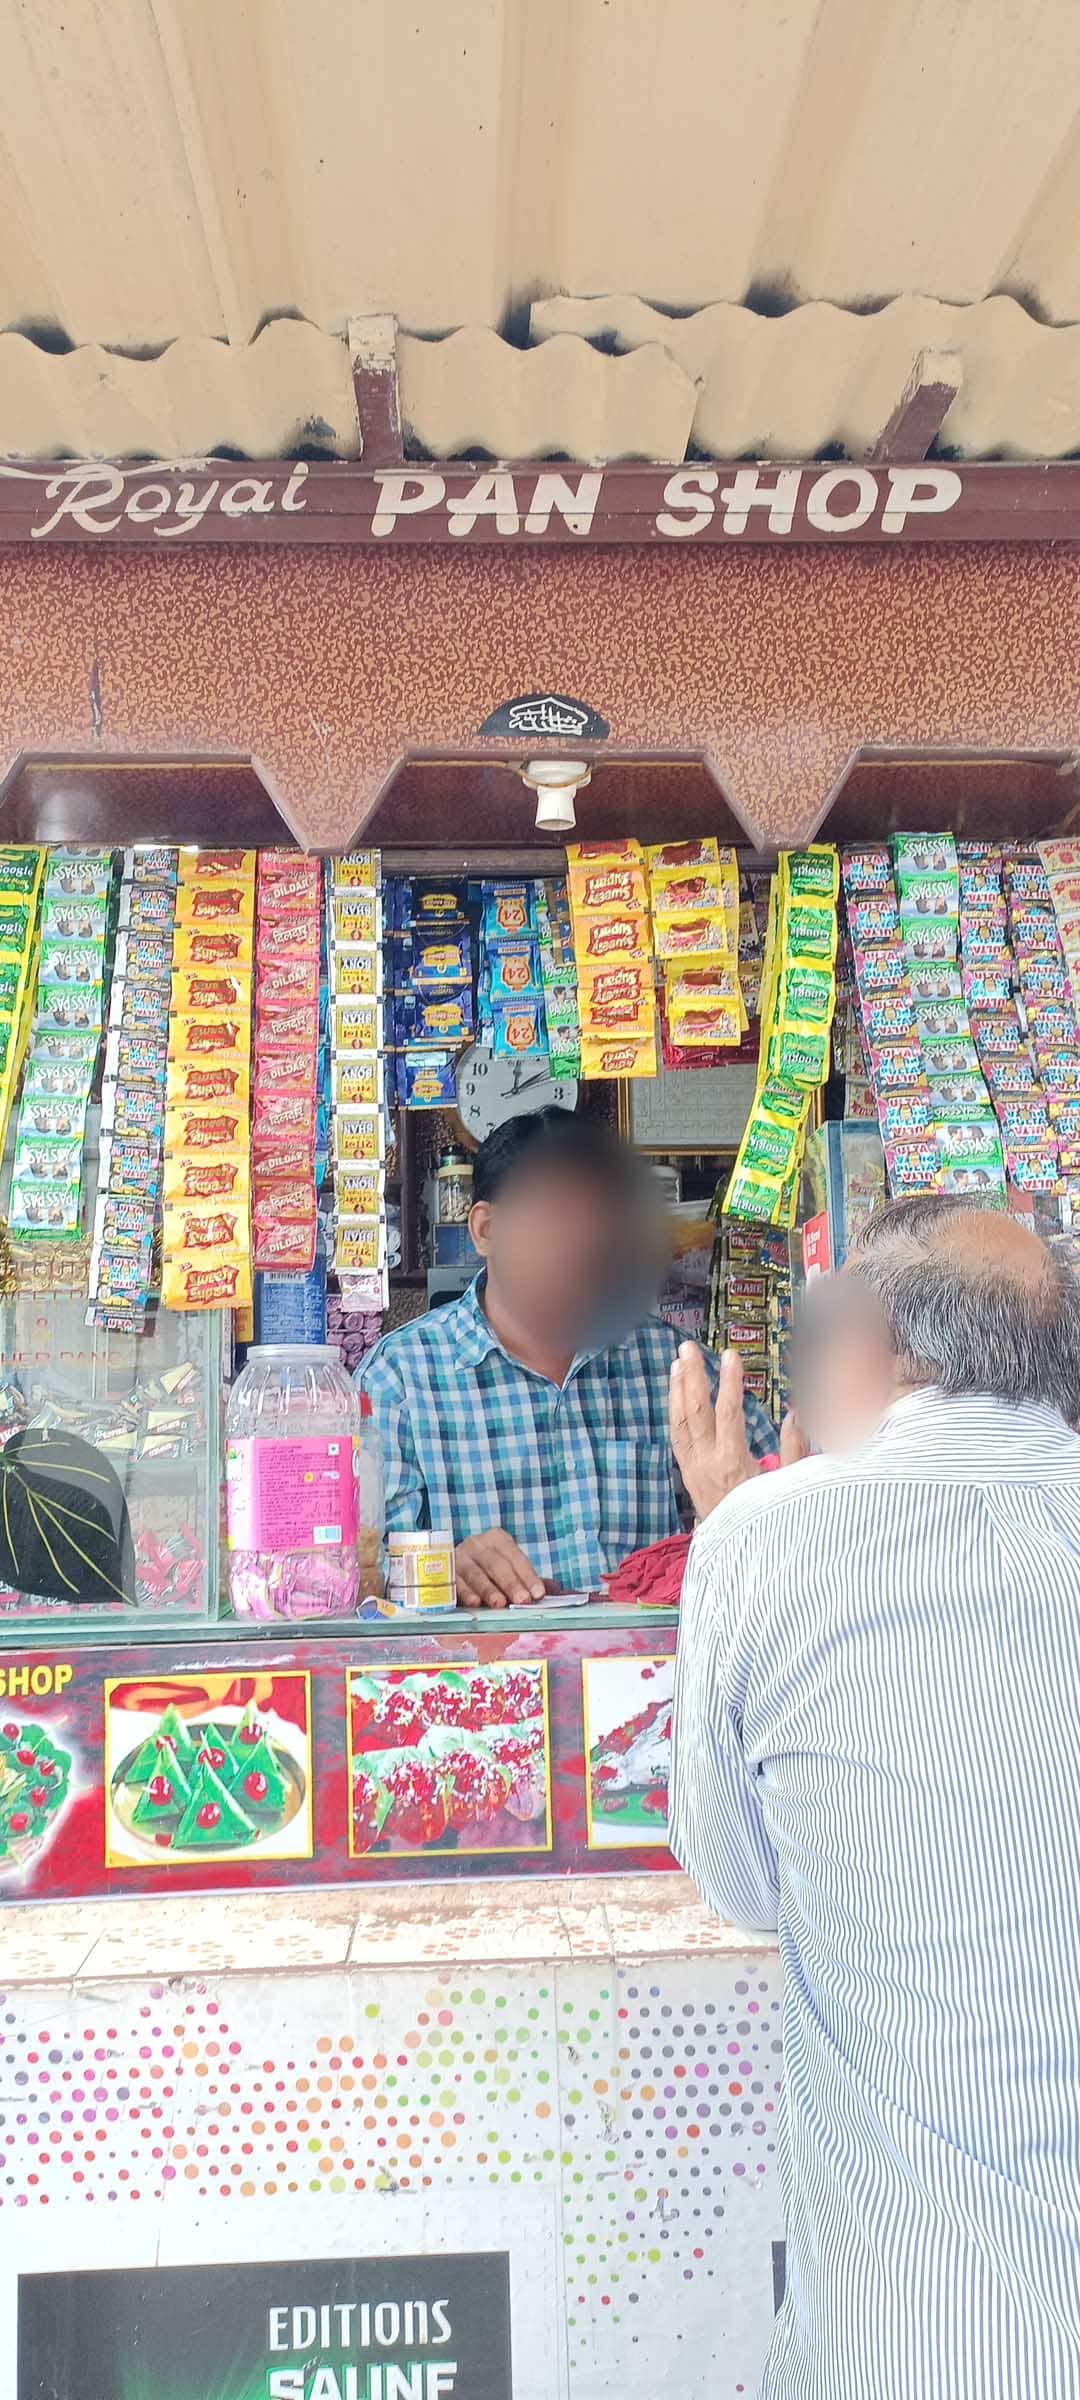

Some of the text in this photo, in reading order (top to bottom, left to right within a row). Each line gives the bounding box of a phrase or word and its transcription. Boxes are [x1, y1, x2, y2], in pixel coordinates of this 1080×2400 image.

[30, 462, 963, 537] Royal PAN SHOP
[851, 854, 883, 864] ULTA
[0, 863, 33, 877] oogle
[792, 865, 832, 877] Google
[273, 879, 309, 898] DILDAR
[858, 902, 889, 912] ULTA
[865, 951, 895, 960] ULTA
[271, 972, 306, 989] DILDAR
[872, 999, 904, 1009] ULTA
[881, 1048, 912, 1058] ULTA
[270, 1064, 305, 1081] DILDAR
[472, 1064, 488, 1077] 10
[466, 1083, 475, 1096] 9
[888, 1097, 921, 1107] ULTA
[470, 1105, 480, 1118] 8
[896, 1144, 929, 1154] ULTA
[267, 1152, 303, 1168] DILDAR
[268, 1234, 305, 1252] DILDAR
[268, 2299, 453, 2352] EDITIONS
